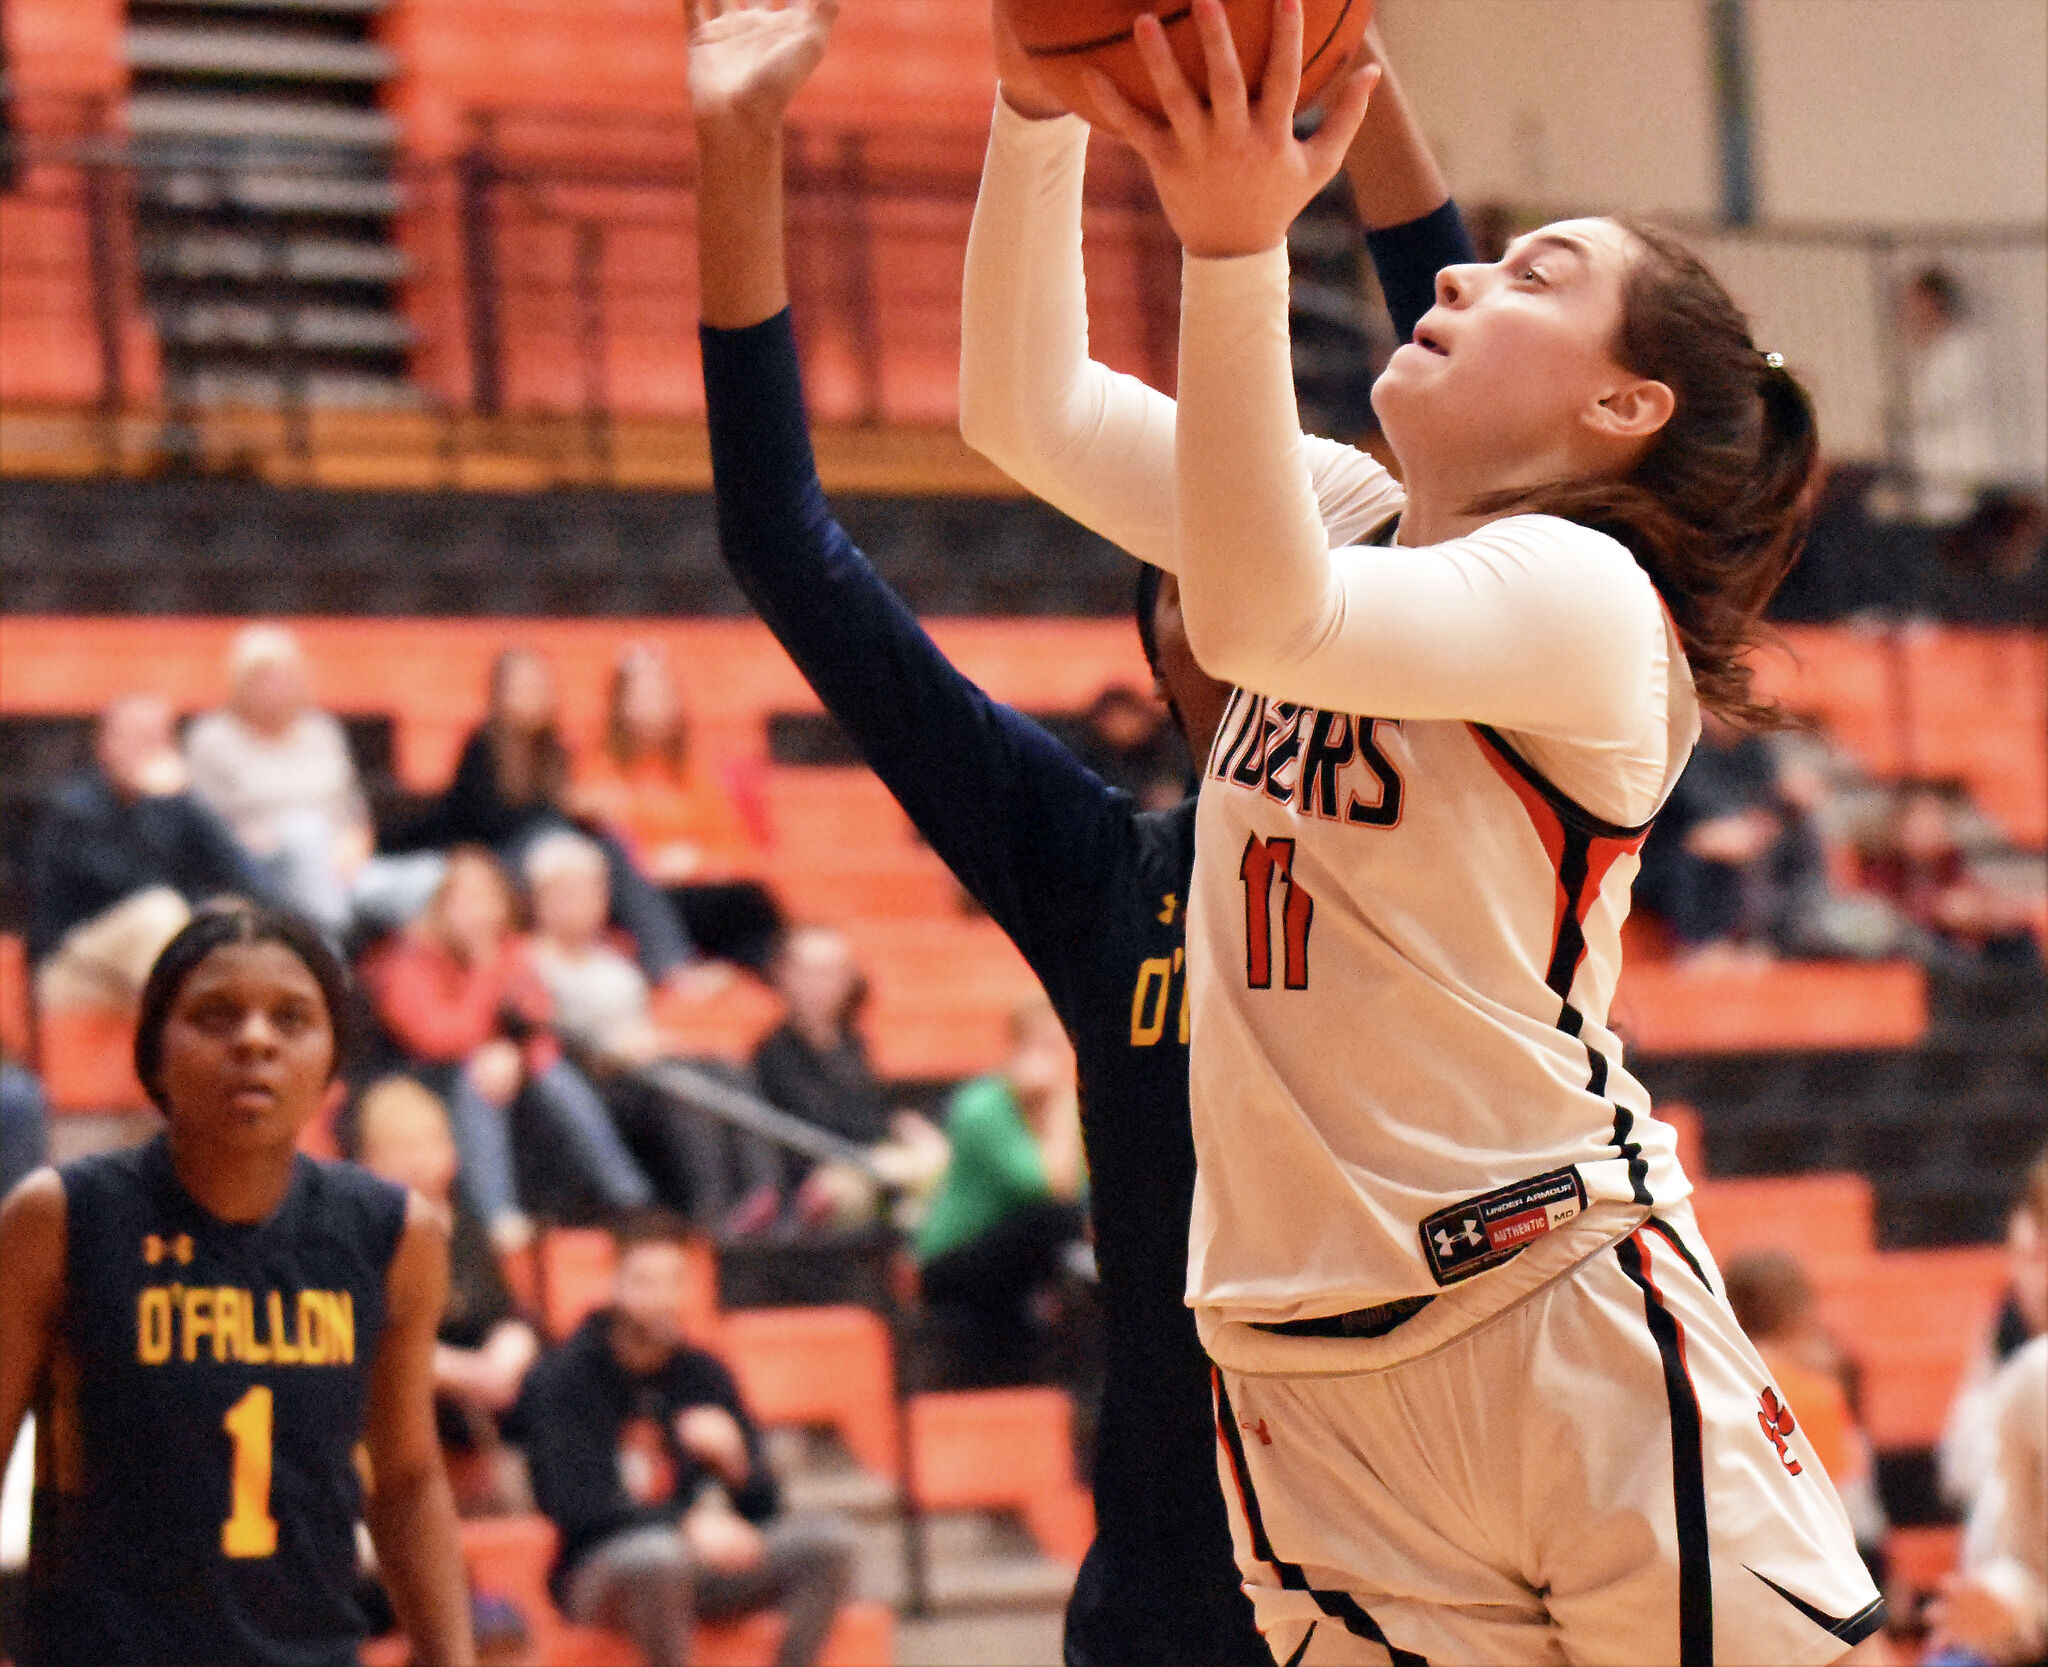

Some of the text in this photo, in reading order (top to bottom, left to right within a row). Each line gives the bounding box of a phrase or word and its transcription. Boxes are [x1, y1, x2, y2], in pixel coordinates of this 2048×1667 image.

[1208, 685, 1405, 830] IGERS
[1239, 829, 1314, 989] 11
[1485, 1182, 1574, 1216] UNDER ARMOUR
[1493, 1209, 1574, 1243] AUTHENTIC MD
[137, 1284, 355, 1365] O'FALLON
[220, 1384, 279, 1559] 1
